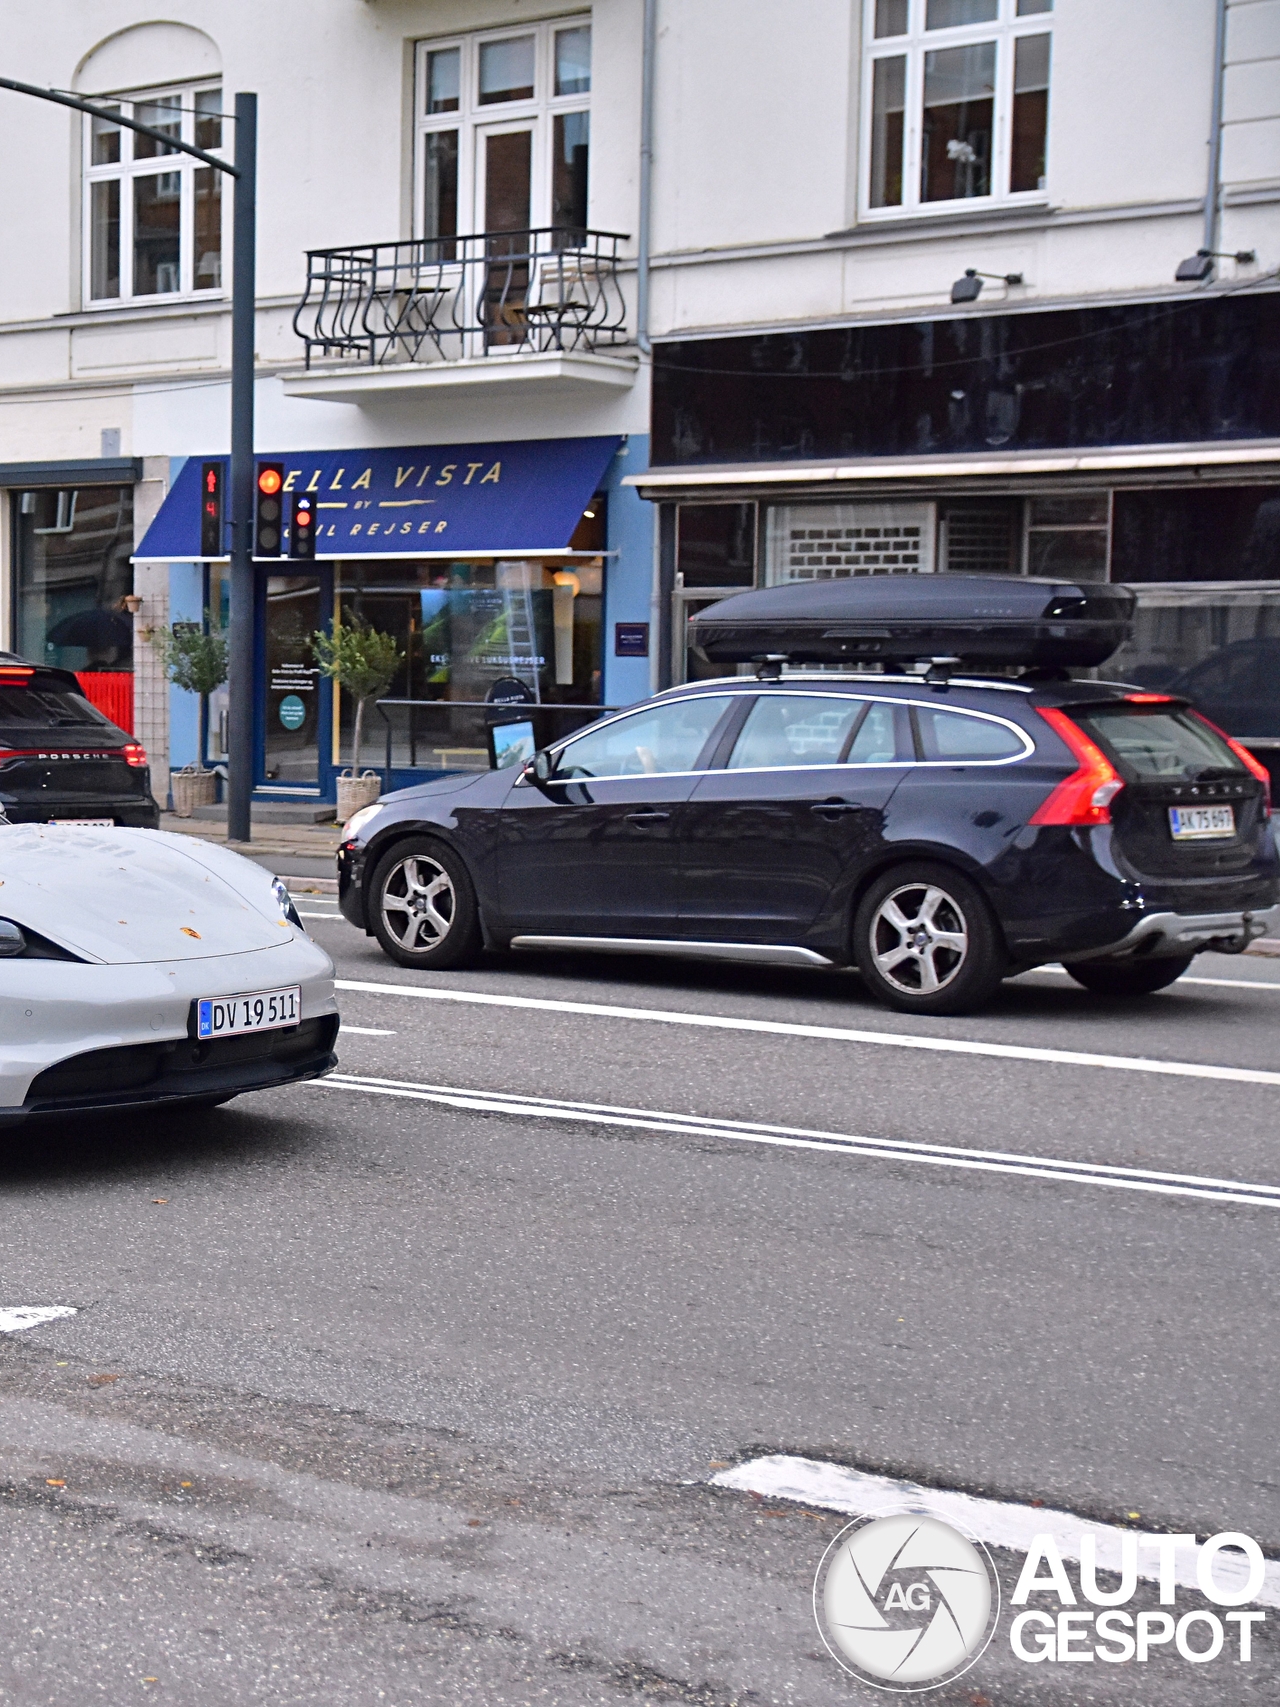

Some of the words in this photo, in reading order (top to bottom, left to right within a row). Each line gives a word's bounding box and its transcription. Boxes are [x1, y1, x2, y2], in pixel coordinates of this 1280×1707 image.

[282, 468, 372, 492] ELLA
[394, 461, 502, 488] VISTA
[353, 499, 372, 510] BY
[349, 520, 448, 536] REJSER
[37, 753, 110, 761] PORSCHE
[213, 1002, 237, 1031] DV
[243, 998, 264, 1026] 19
[268, 993, 296, 1023] 511
[201, 1022, 210, 1031] DK
